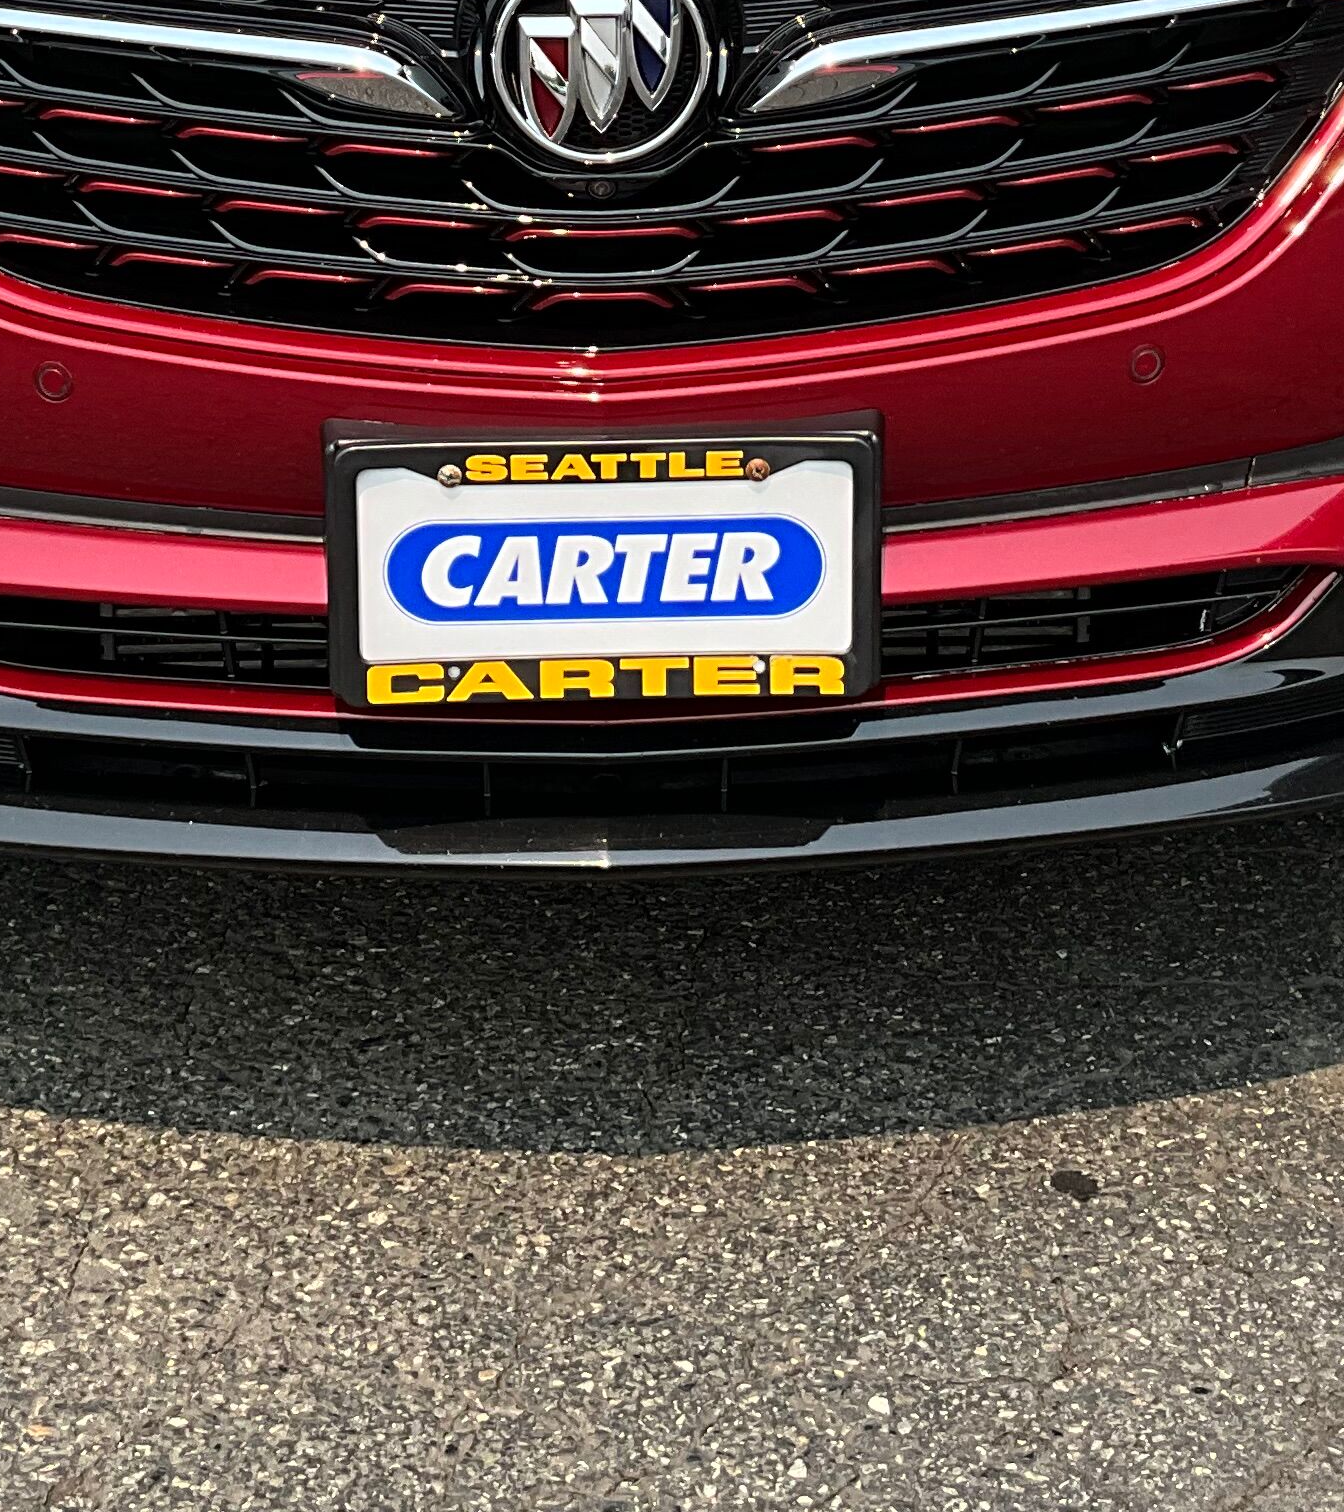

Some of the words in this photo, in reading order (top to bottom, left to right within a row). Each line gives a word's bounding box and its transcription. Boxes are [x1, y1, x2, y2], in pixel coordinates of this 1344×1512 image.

[465, 450, 745, 482] SEATTLE
[420, 531, 781, 608] CARTER
[367, 655, 846, 705] CARTER
